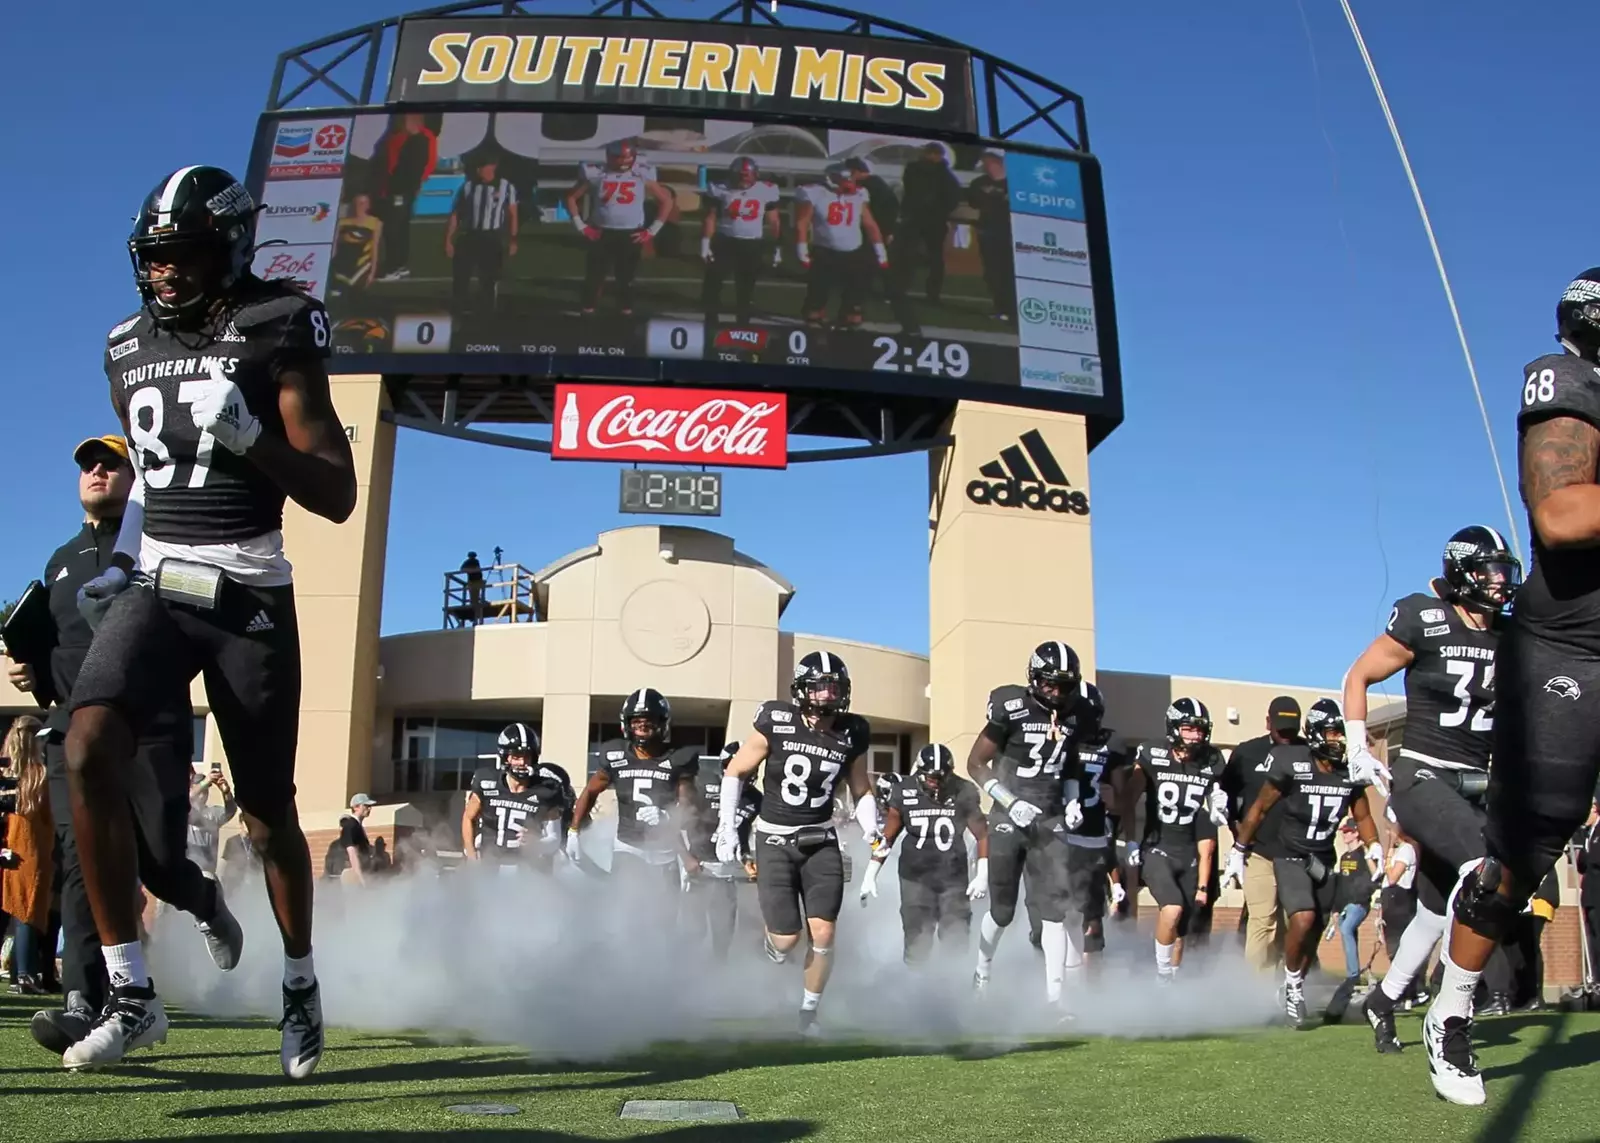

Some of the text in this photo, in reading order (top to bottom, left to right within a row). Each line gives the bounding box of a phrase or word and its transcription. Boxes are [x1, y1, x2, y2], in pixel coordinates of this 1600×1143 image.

[417, 32, 945, 110] SOUTHERN MISS
[602, 182, 637, 204] 75
[728, 199, 761, 221] 43
[827, 201, 854, 226] 61
[264, 252, 315, 280] Bok
[416, 321, 435, 345] 0
[669, 327, 688, 351] 0
[729, 331, 759, 344] WKU
[788, 330, 807, 354] 0
[466, 344, 500, 352] DOWN
[521, 344, 557, 353] TO GO
[578, 346, 625, 356] BALL ON
[872, 336, 970, 378] 2:49
[786, 356, 810, 365] QTR
[122, 358, 197, 389] SOUTHERN
[1524, 368, 1555, 406] 68
[129, 386, 216, 489] 87
[587, 395, 780, 456] Coca-Cola
[645, 474, 719, 511] 2:49
[966, 476, 1090, 516] adidas
[1439, 645, 1494, 661] SOUTHERN
[1439, 660, 1497, 731] 32
[782, 740, 828, 758] SOUTHERN
[1016, 732, 1068, 780] 34
[618, 769, 653, 779] SOUTHERN
[781, 754, 841, 808] 83
[1157, 771, 1194, 783] SOUTHERN
[1300, 784, 1338, 795] SOUTHERN
[490, 798, 522, 809] SOUTHERN
[908, 808, 940, 818] SOUTHERN
[1158, 781, 1205, 825] 85
[495, 806, 528, 848] 15
[1306, 794, 1343, 841] 13
[910, 816, 956, 852] 70
